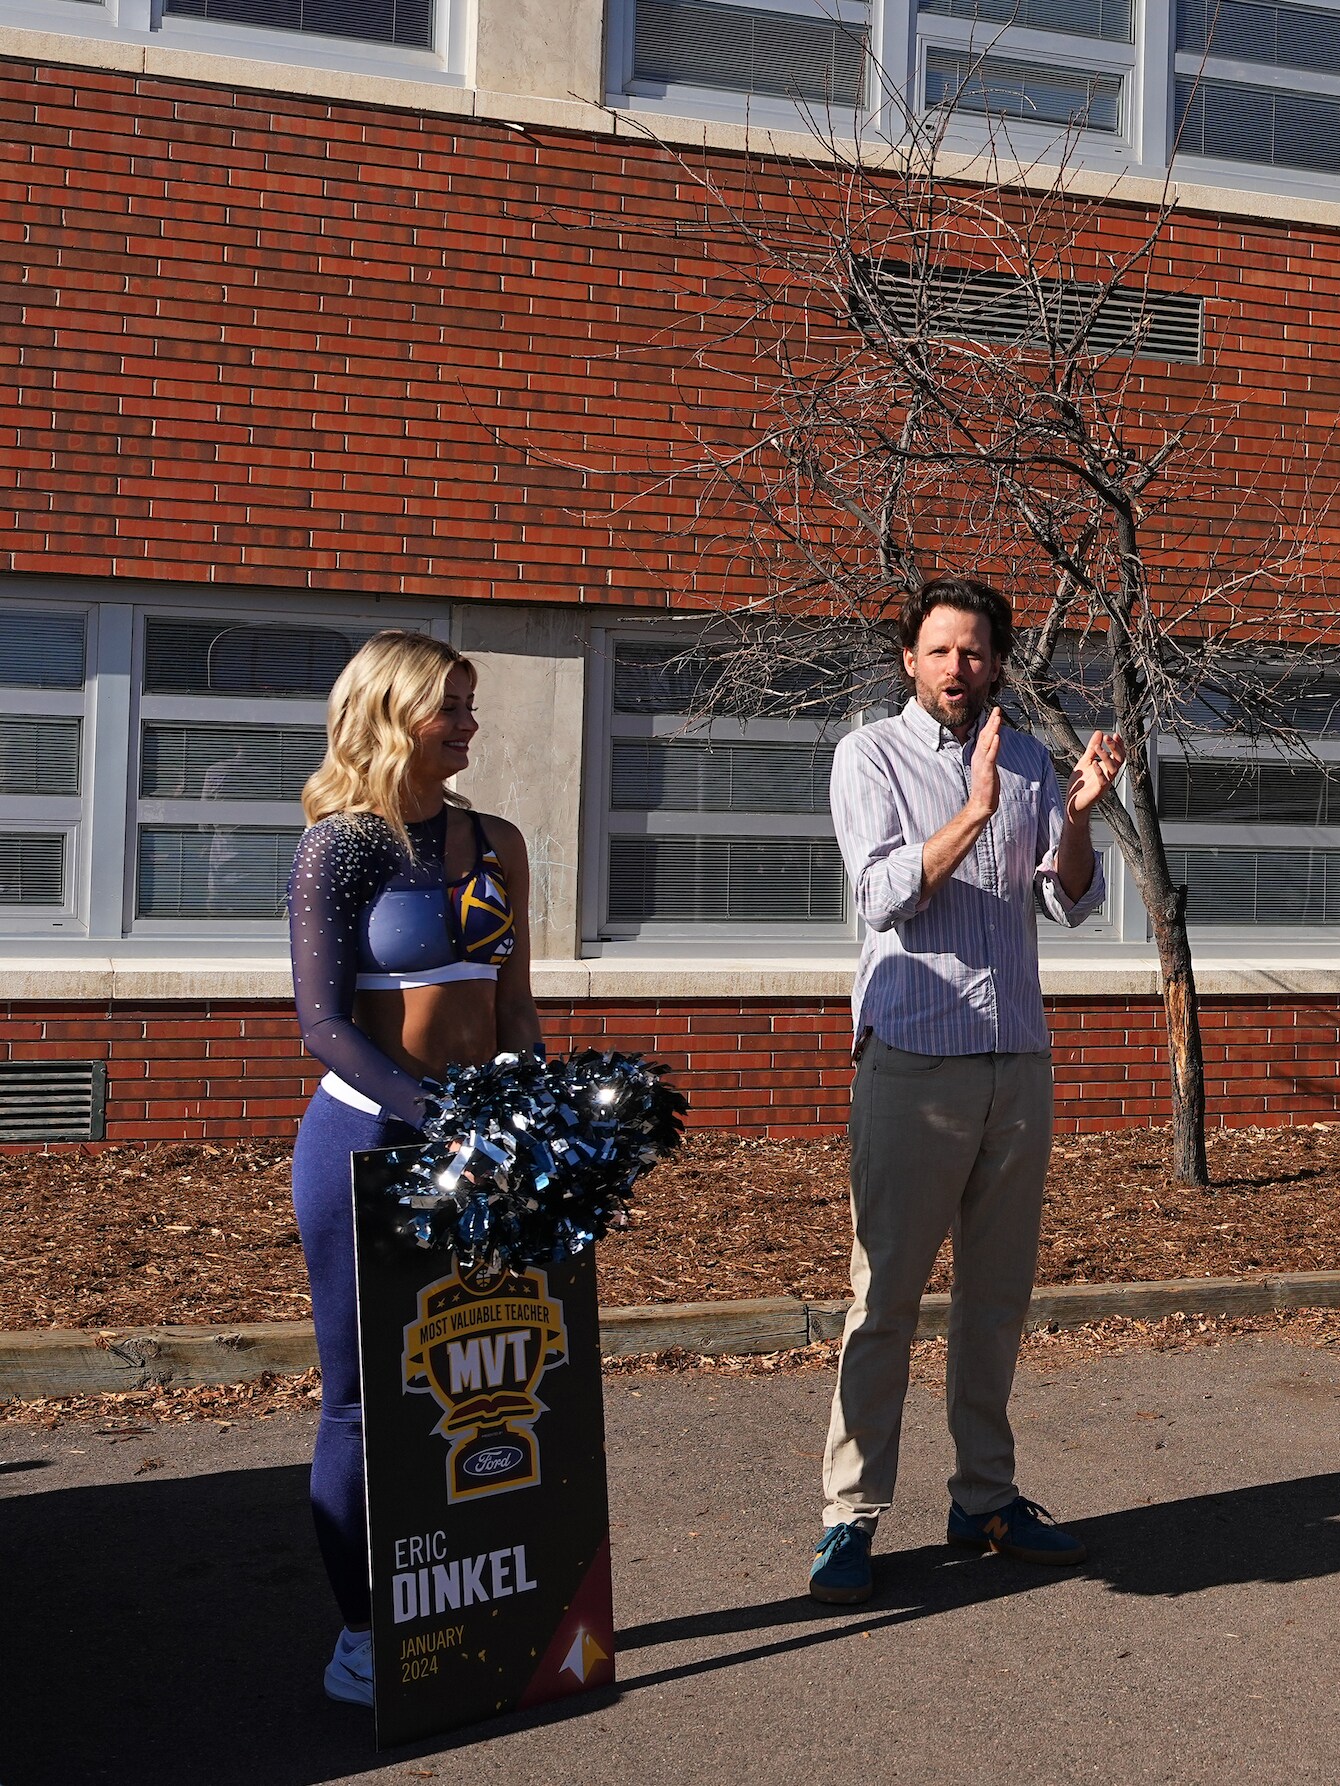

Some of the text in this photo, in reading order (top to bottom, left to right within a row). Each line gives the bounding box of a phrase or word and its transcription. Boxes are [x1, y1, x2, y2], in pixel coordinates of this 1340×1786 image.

[420, 1303, 550, 1345] MOST VALUABLE TEACHER
[446, 1329, 532, 1396] MVT
[474, 1450, 512, 1473] Ford
[395, 1530, 447, 1569] ERIC
[392, 1544, 538, 1624] DINKEL
[401, 1624, 465, 1661] JANUARY
[401, 1656, 439, 1683] 2024
